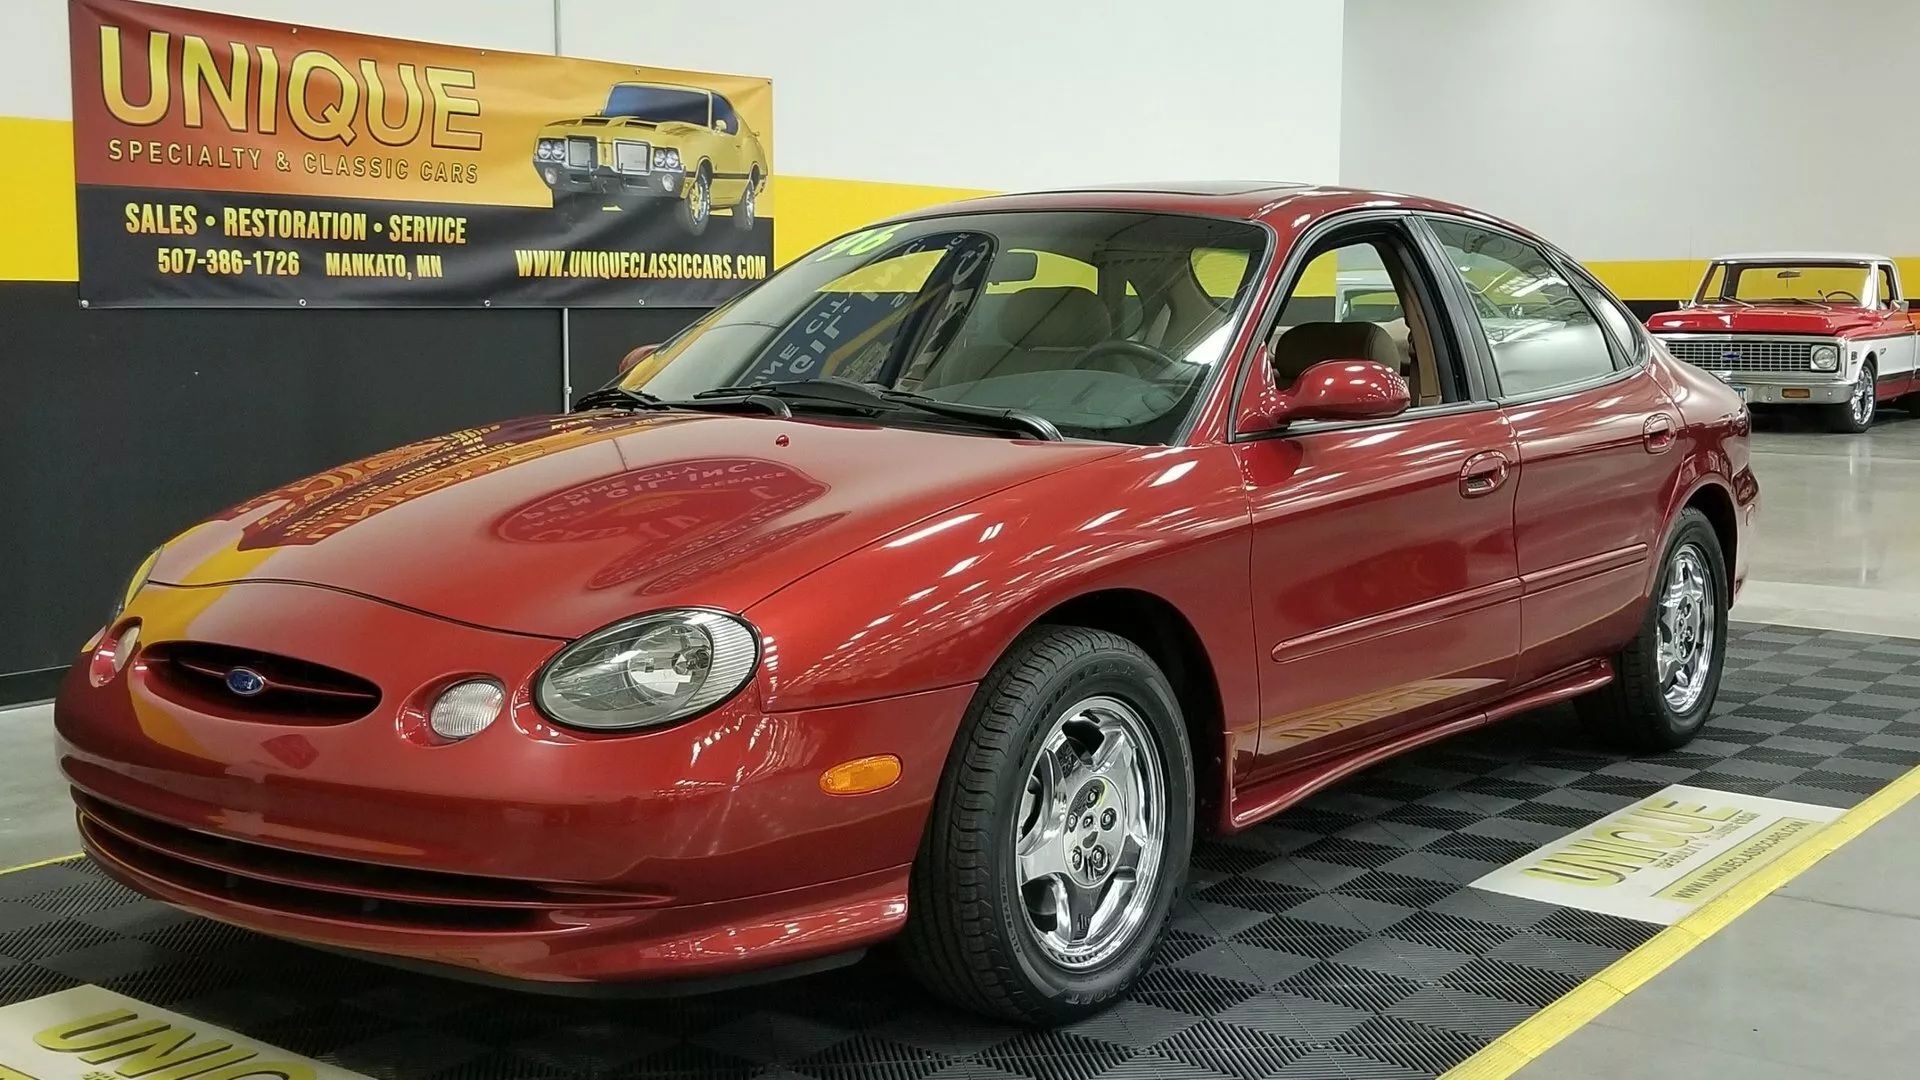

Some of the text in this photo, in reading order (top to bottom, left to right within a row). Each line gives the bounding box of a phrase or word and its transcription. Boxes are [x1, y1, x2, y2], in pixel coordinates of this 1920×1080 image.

[100, 25, 483, 151] UNIQUE
[108, 138, 478, 183] SPECIALTY & CLASSIC CARS
[125, 203, 467, 244] SALES RESTORATION SERVICE
[158, 247, 443, 281] 507-386-1726 MANKATO, MN
[515, 249, 766, 280] WWW.UNIQUECLASSICCARS.COM
[1521, 799, 1744, 888] UNIQUE
